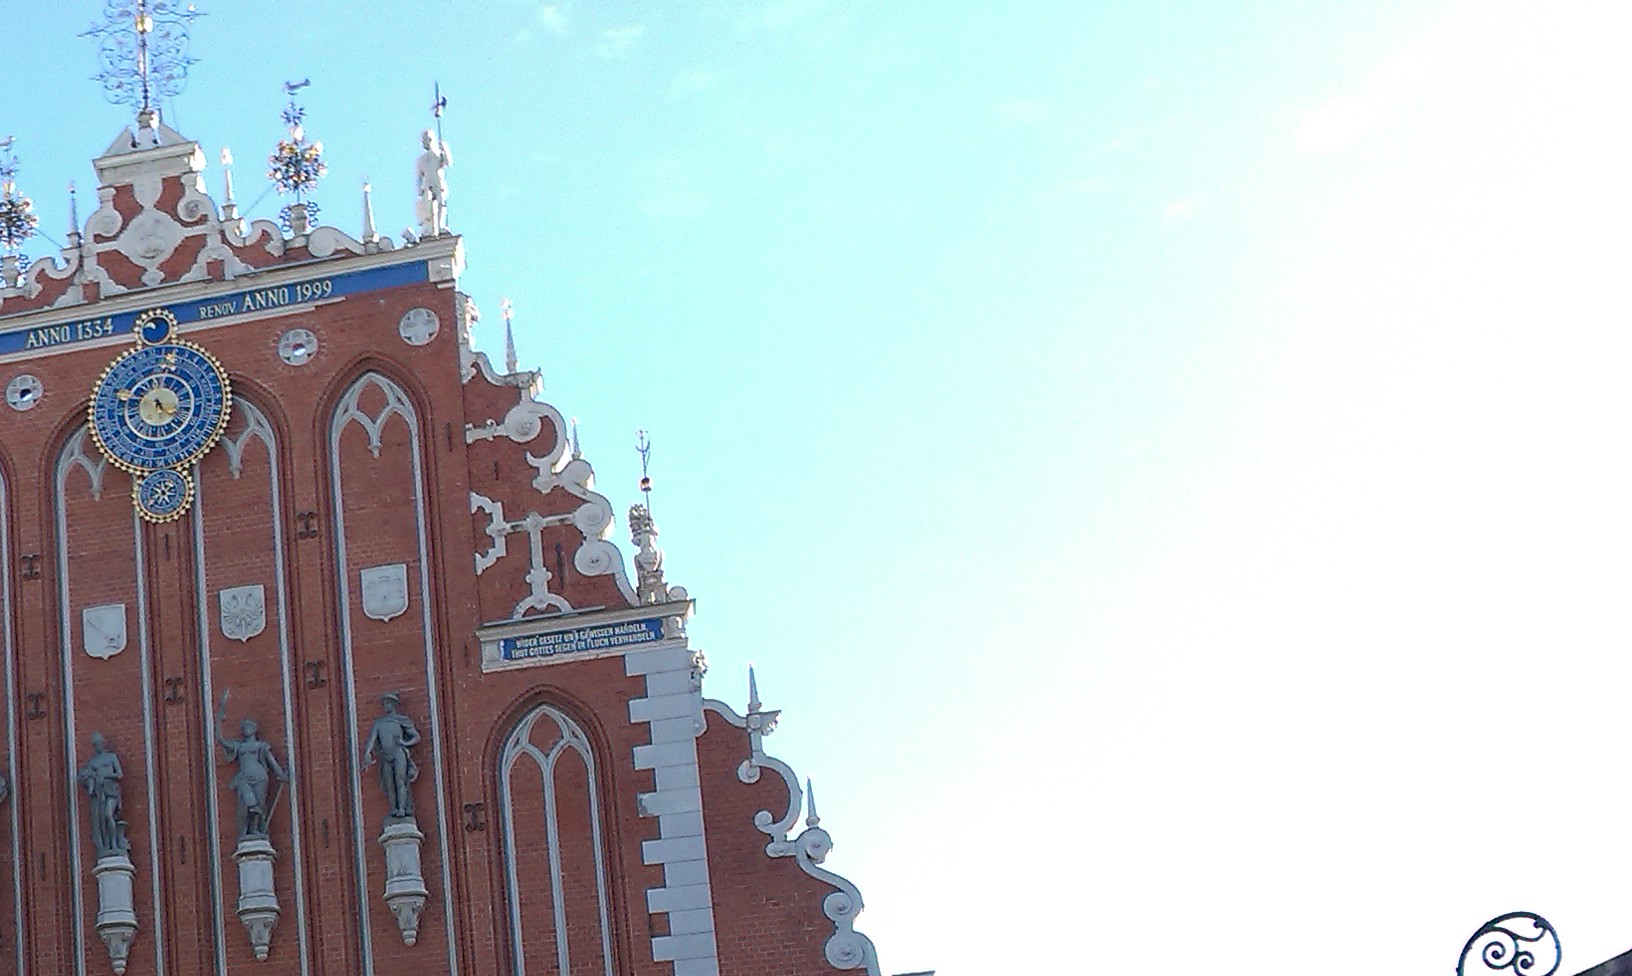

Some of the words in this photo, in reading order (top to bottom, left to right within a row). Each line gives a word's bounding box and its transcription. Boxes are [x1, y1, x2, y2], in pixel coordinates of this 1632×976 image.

[243, 288, 289, 312] ANNO
[296, 280, 332, 302] 1999
[25, 326, 70, 349] ANNO
[77, 317, 113, 339] 1334
